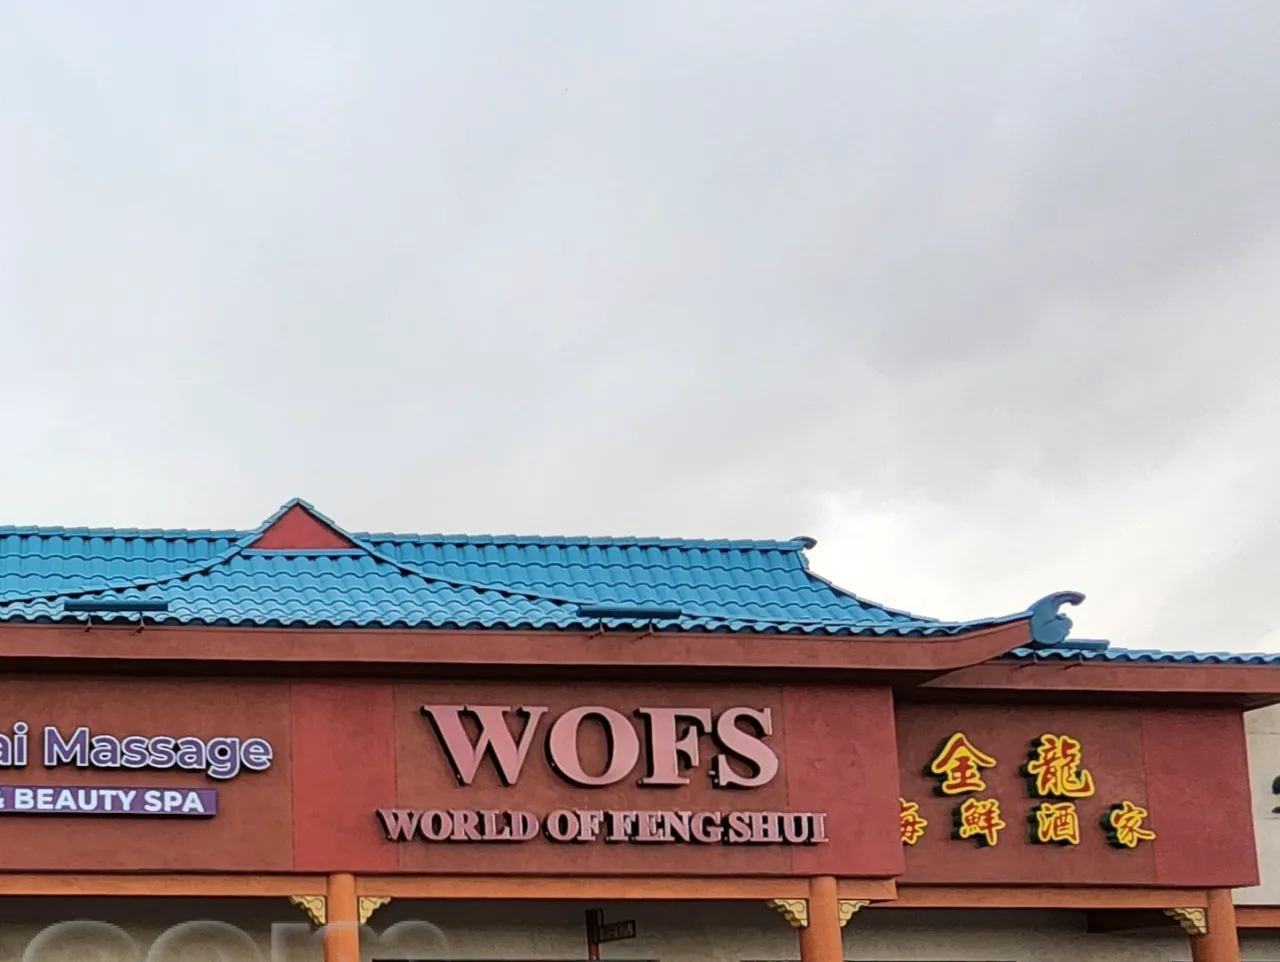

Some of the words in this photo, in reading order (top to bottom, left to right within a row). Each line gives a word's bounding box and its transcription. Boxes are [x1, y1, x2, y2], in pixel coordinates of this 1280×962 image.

[43, 725, 273, 779] Massage
[422, 704, 779, 786] WOFS
[931, 732, 1095, 797] 金龍
[14, 788, 137, 812] BEAUTY
[143, 790, 205, 813] SPA
[376, 808, 539, 841] WORLD
[546, 809, 606, 842] OF
[606, 810, 724, 842] FENG
[726, 811, 829, 843] SHUI
